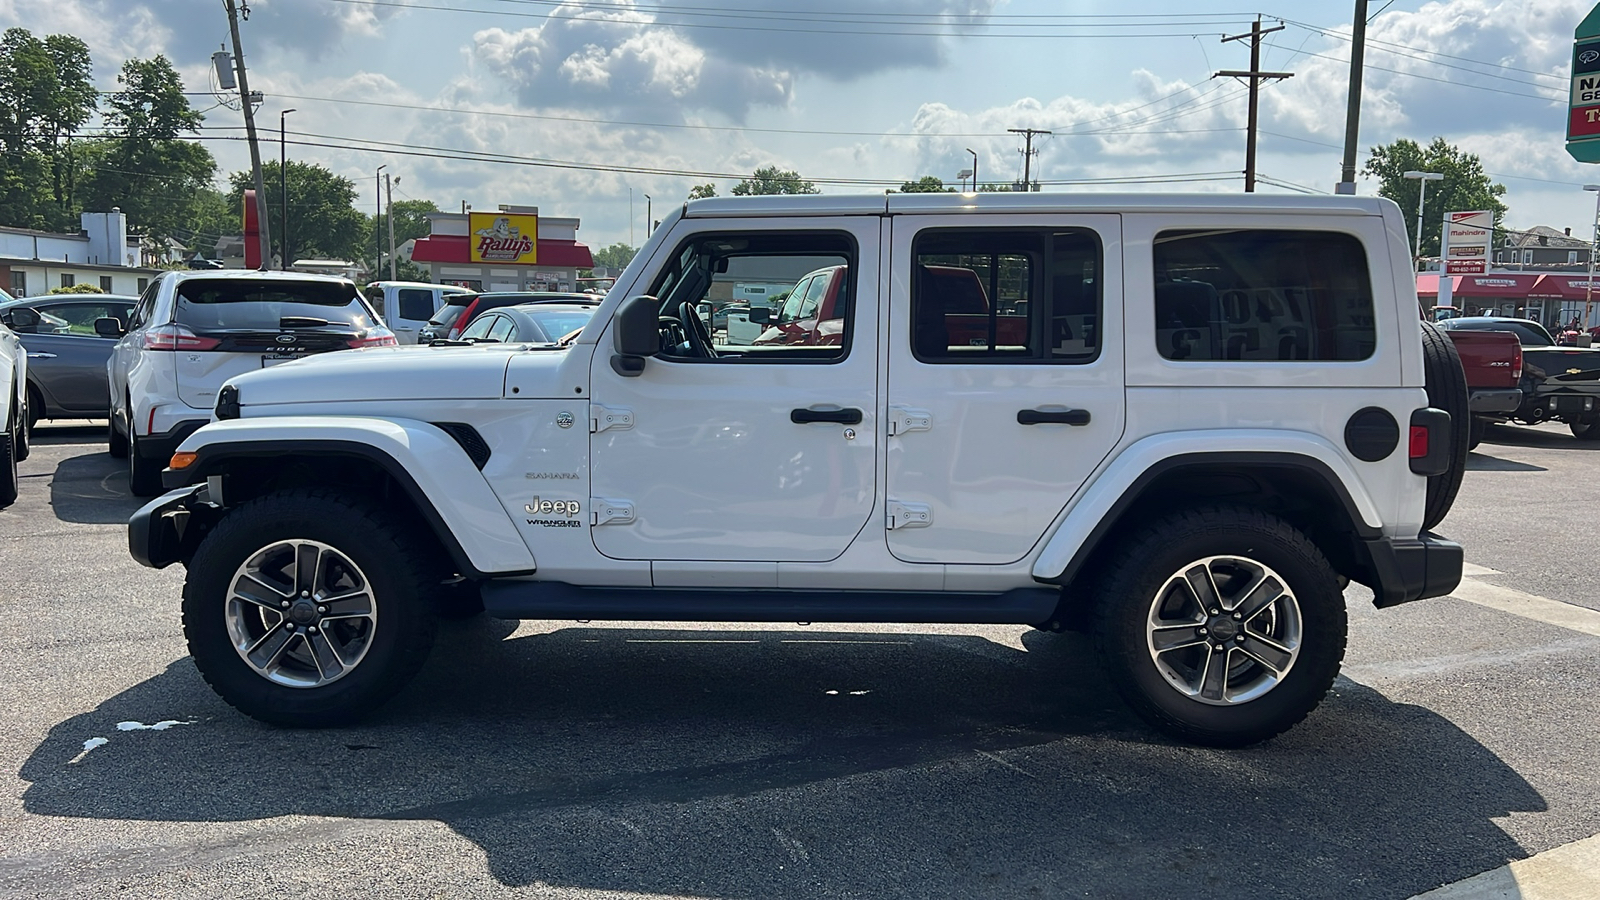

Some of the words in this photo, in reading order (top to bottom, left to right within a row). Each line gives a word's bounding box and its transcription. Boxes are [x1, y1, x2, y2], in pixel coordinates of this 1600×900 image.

[1585, 108, 1600, 123] T
[477, 235, 533, 260] Rally's
[525, 472, 580, 480] SAHARA
[525, 495, 581, 518] Jeep
